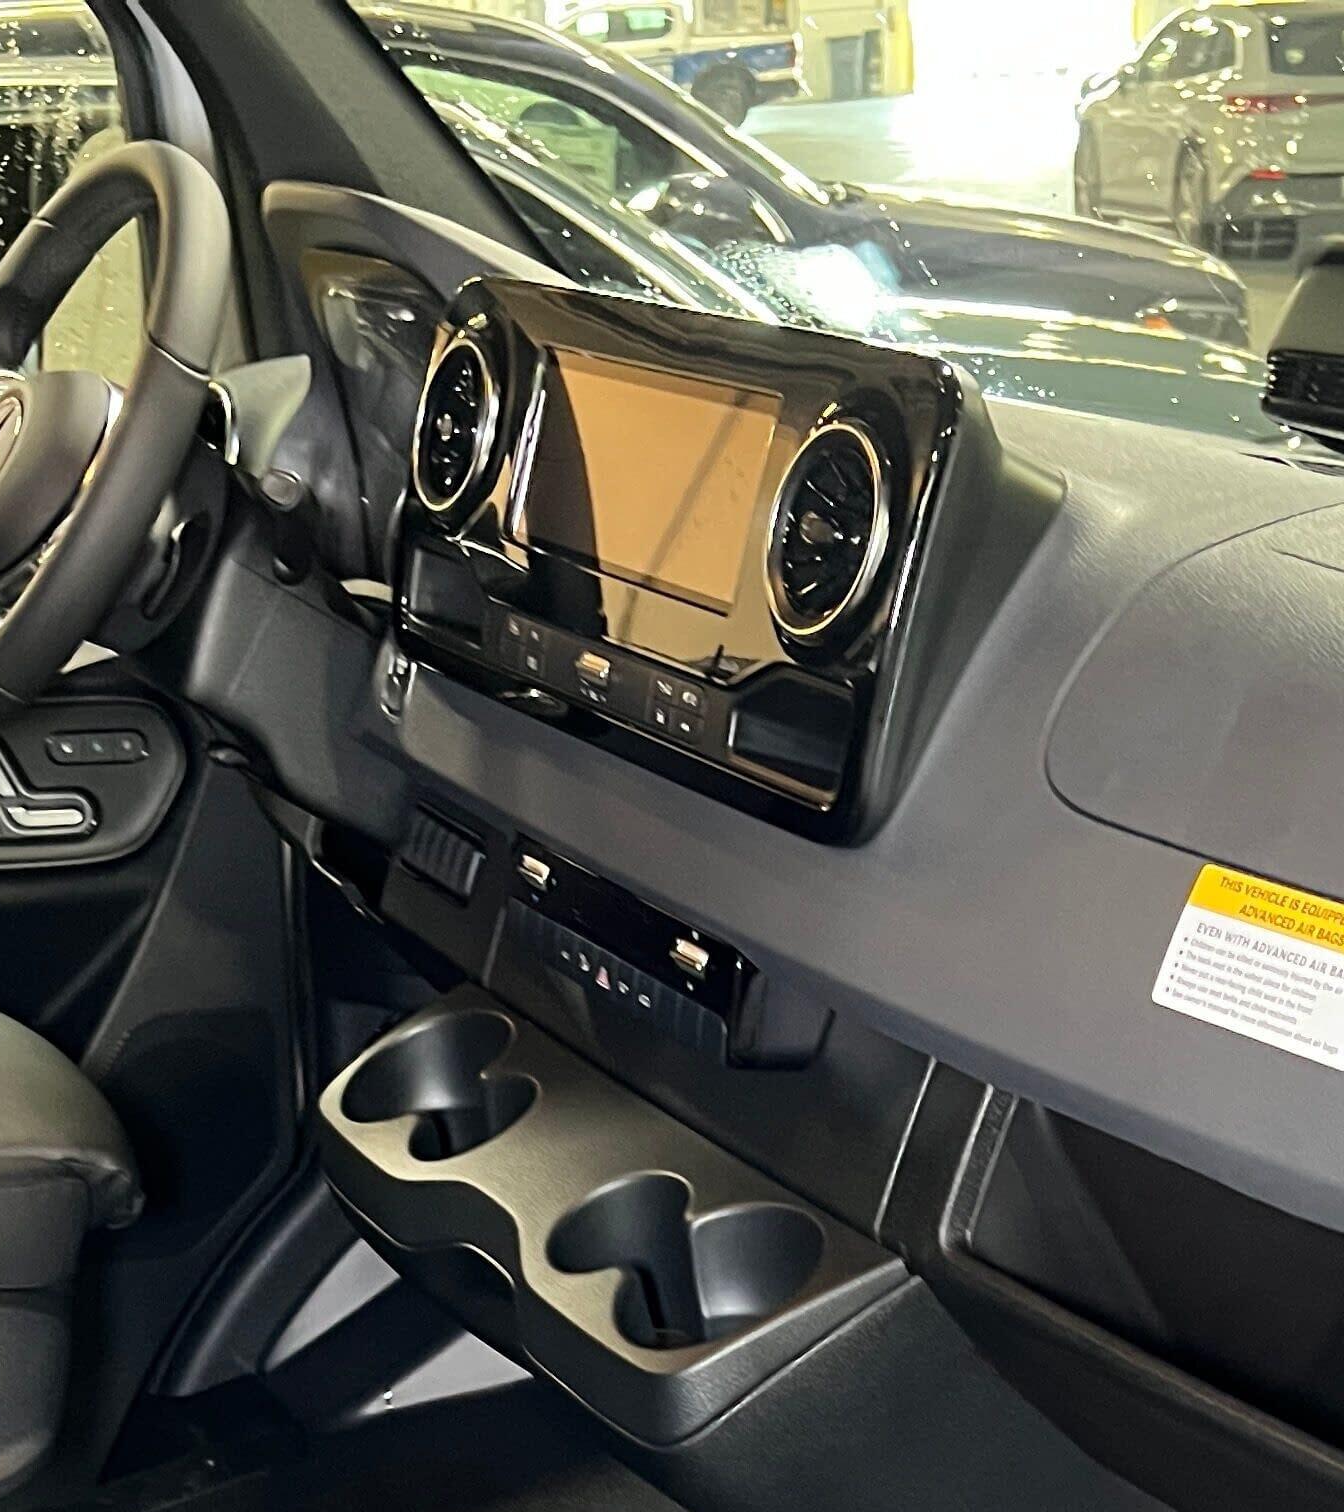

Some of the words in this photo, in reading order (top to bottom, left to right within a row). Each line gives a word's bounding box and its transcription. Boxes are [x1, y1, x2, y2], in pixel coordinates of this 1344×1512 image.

[1219, 876, 1243, 892] THIS
[1243, 884, 1289, 906] VEHICLE
[1288, 897, 1300, 910] IS
[1238, 903, 1296, 930] ADVANCED
[1296, 921, 1316, 936] AIR
[1196, 922, 1223, 939] EVEN
[1223, 931, 1250, 948] WITH
[1251, 939, 1307, 967] ADVANCED
[1308, 958, 1328, 974] AIR
